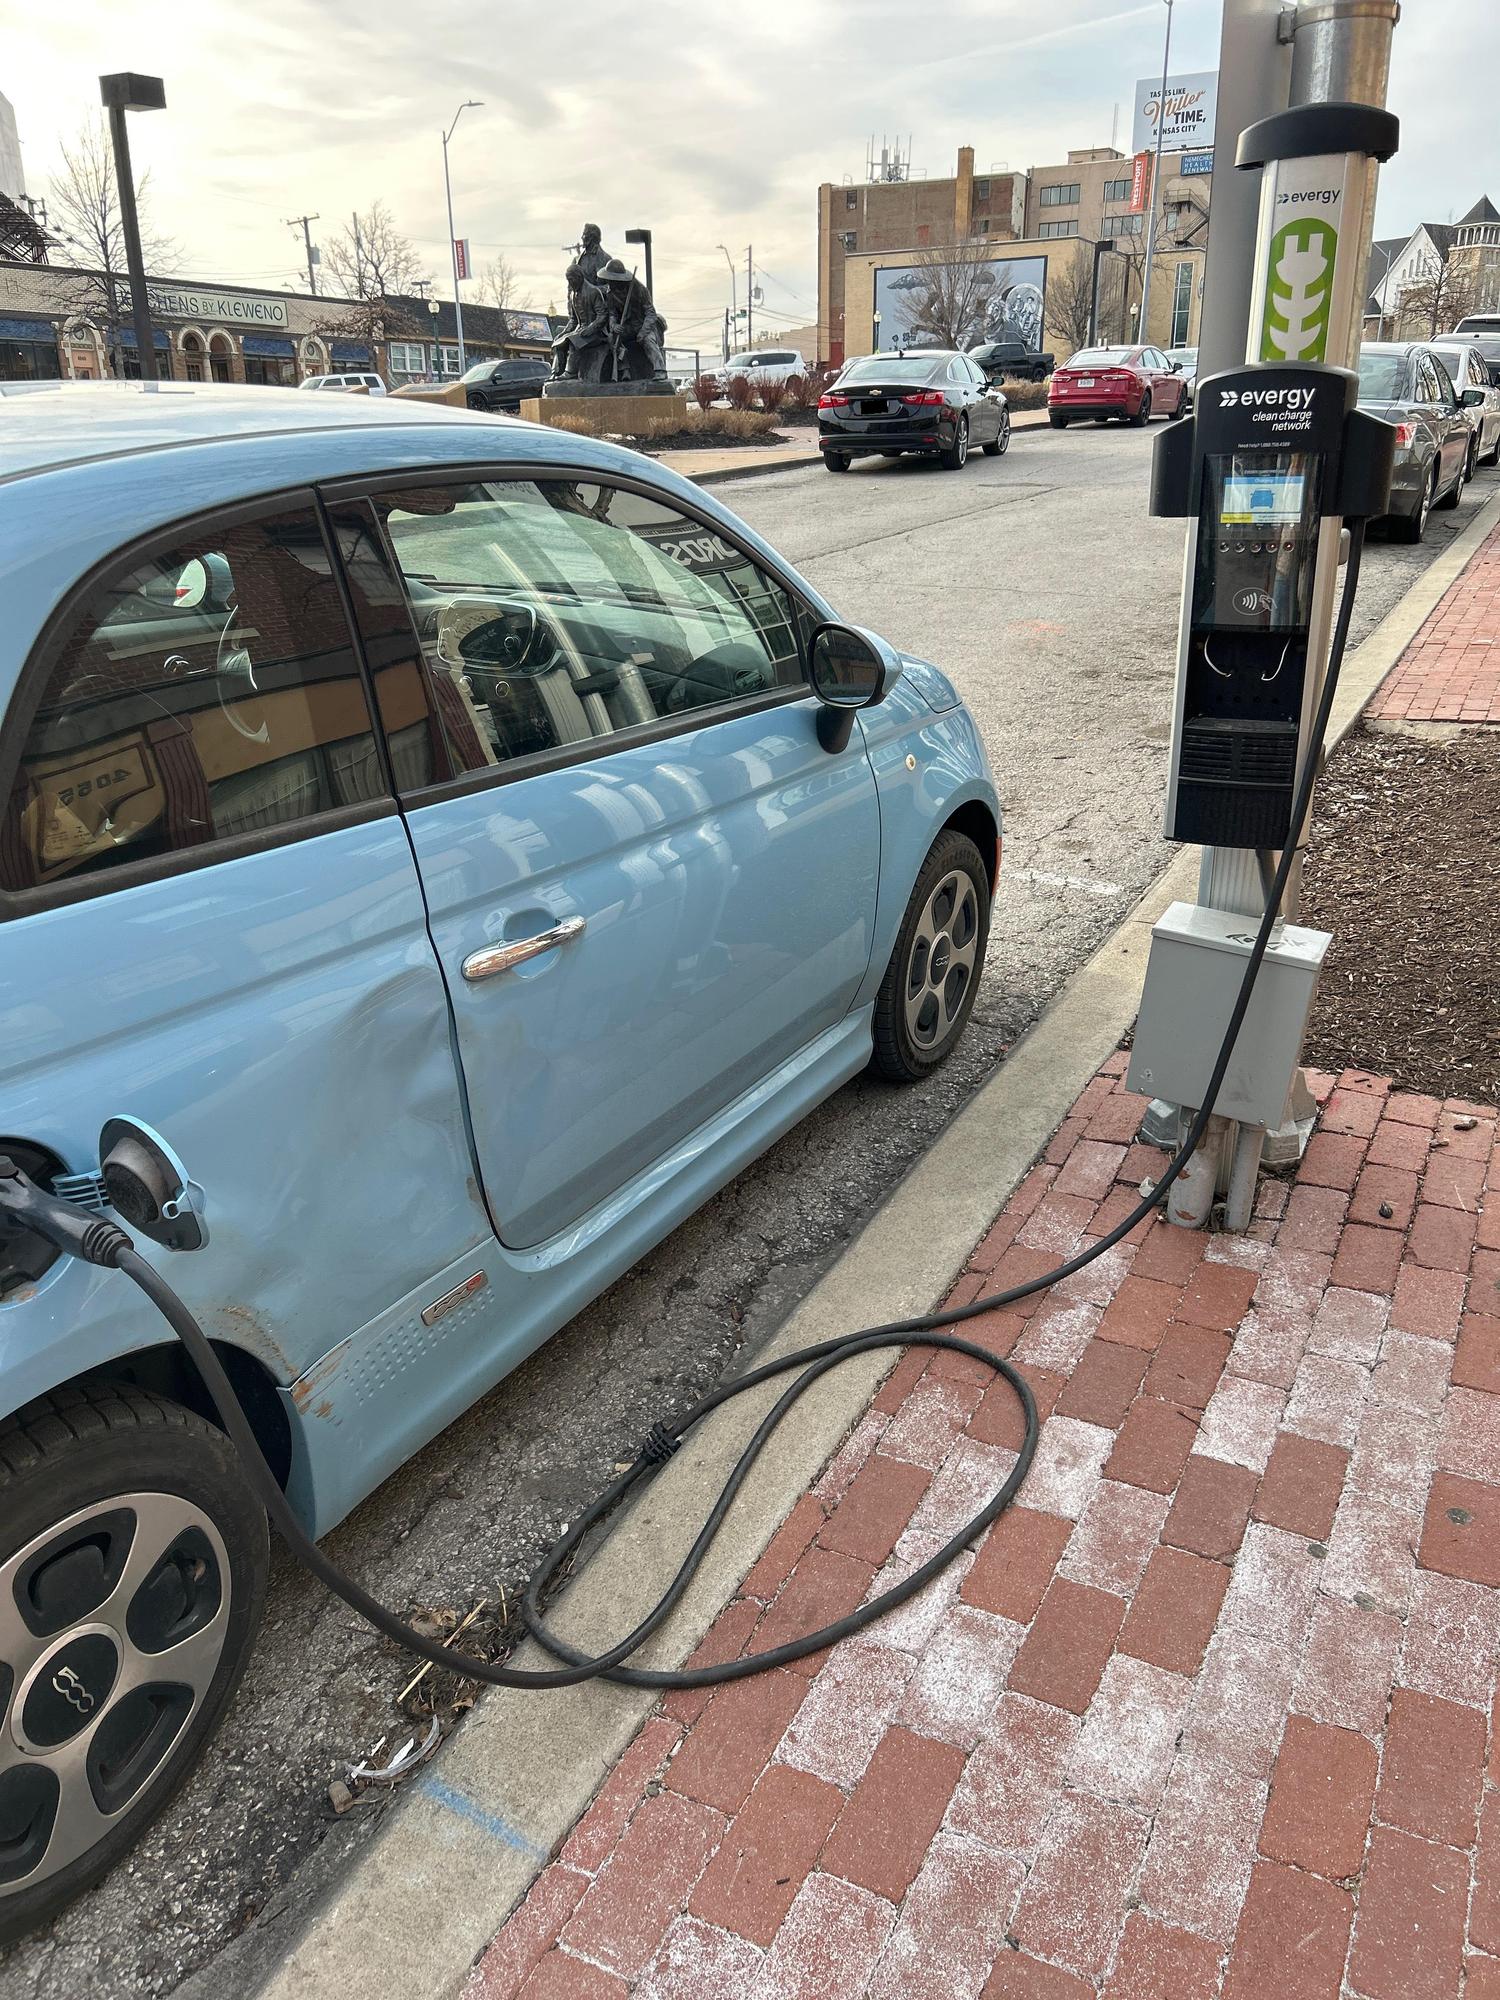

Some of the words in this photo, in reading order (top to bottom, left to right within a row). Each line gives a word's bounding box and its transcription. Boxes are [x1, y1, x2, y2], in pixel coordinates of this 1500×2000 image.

[1150, 89, 1171, 98] TASES
[1172, 88, 1186, 96] LIKE
[1143, 90, 1206, 126] Miller
[1173, 109, 1207, 124] TIME,
[1153, 126, 1180, 135] KNSAS
[1181, 124, 1197, 132] CITY
[1132, 160, 1142, 207] WESTPORT
[1291, 189, 1341, 204] evergy
[202, 301, 215, 312] BY
[217, 300, 283, 321] KLEWENO
[1240, 388, 1316, 409] evergy
[1252, 411, 1277, 421] clean
[1278, 410, 1312, 421] charge
[1271, 420, 1312, 431] network
[52, 1666, 95, 1713] 500
